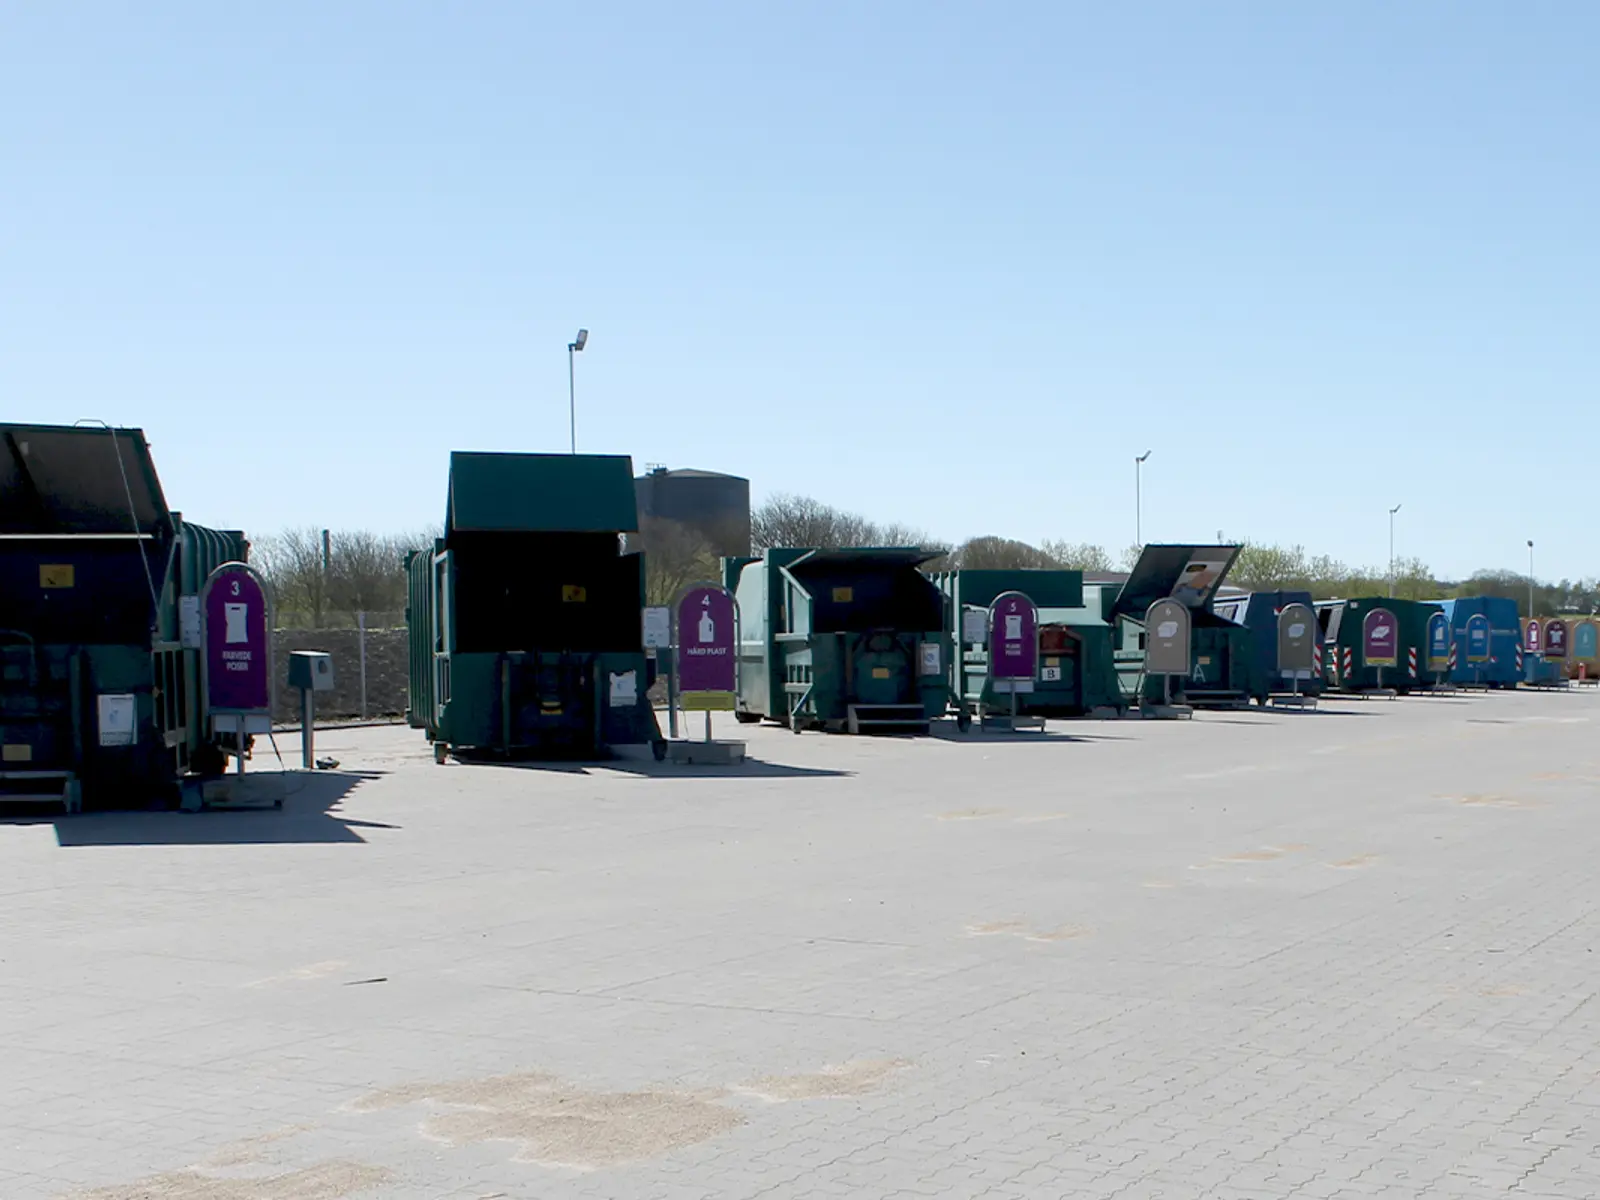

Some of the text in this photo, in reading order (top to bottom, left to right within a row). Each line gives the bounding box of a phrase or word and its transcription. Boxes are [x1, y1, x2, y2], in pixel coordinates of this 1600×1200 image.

[231, 580, 241, 596] 3
[701, 594, 710, 606] 4
[1009, 602, 1017, 612] 5
[1165, 607, 1172, 617] 6
[687, 647, 726, 655] HÅRD PLAST
[1047, 668, 1056, 679] B
[1192, 663, 1206, 683] A
